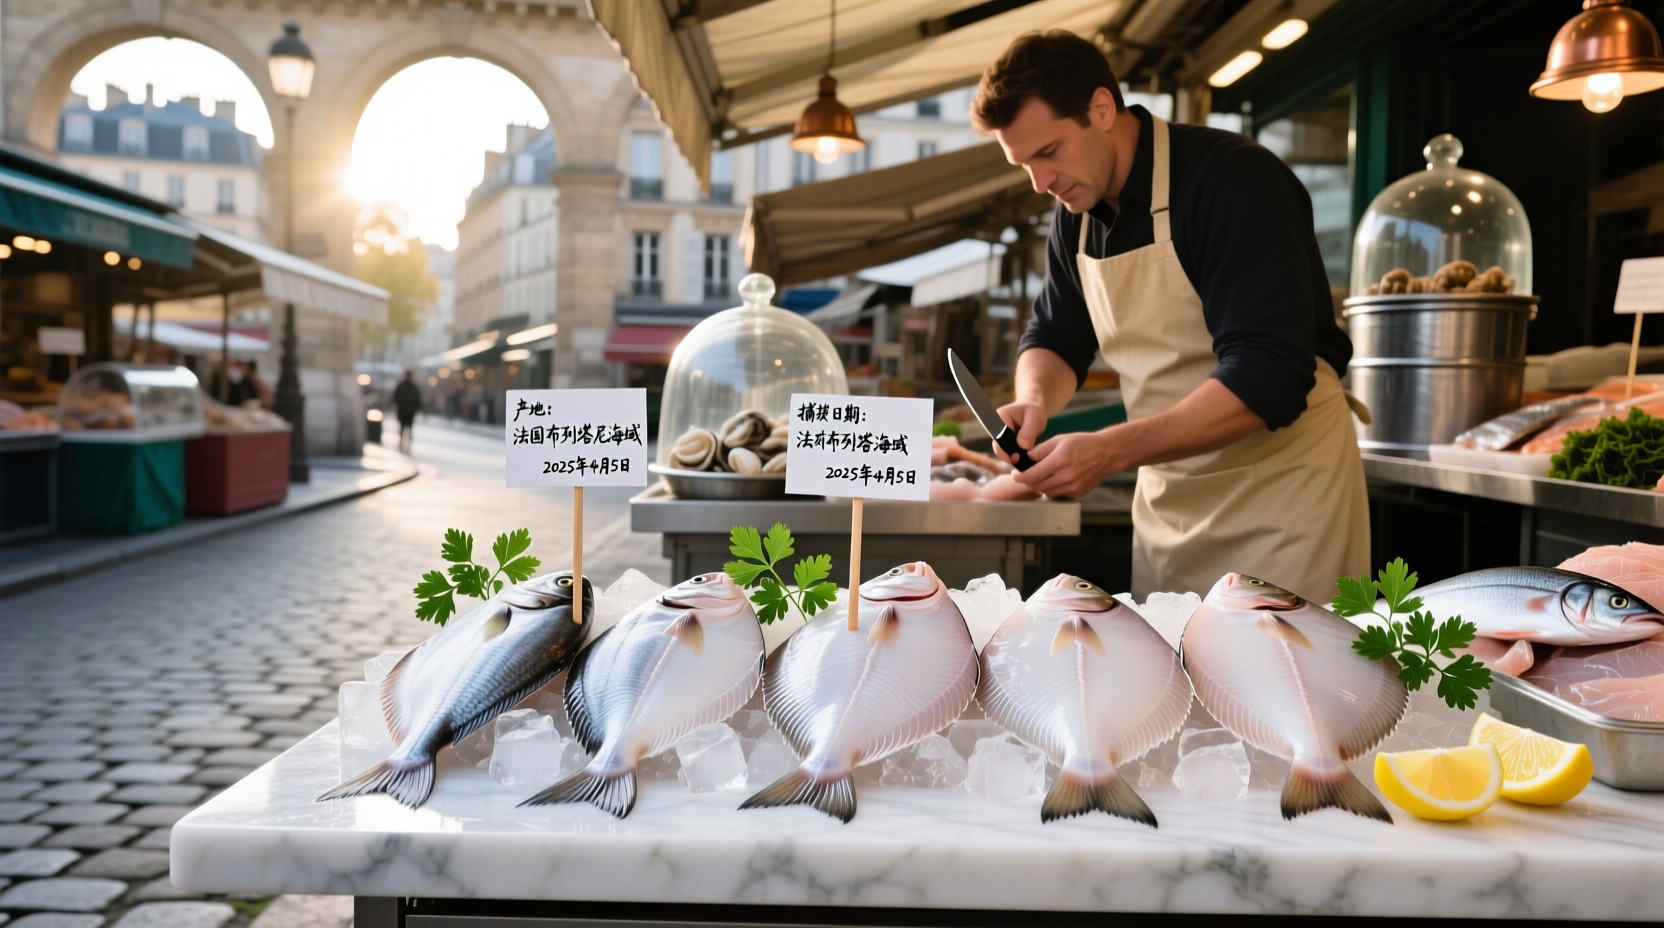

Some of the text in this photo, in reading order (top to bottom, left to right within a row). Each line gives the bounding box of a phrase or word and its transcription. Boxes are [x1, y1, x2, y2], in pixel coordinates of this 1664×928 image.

[513, 422, 643, 449] 法国布列塔尼海域
[543, 455, 630, 477] 2025年4月5日
[825, 463, 916, 487] 2025年4月5日
